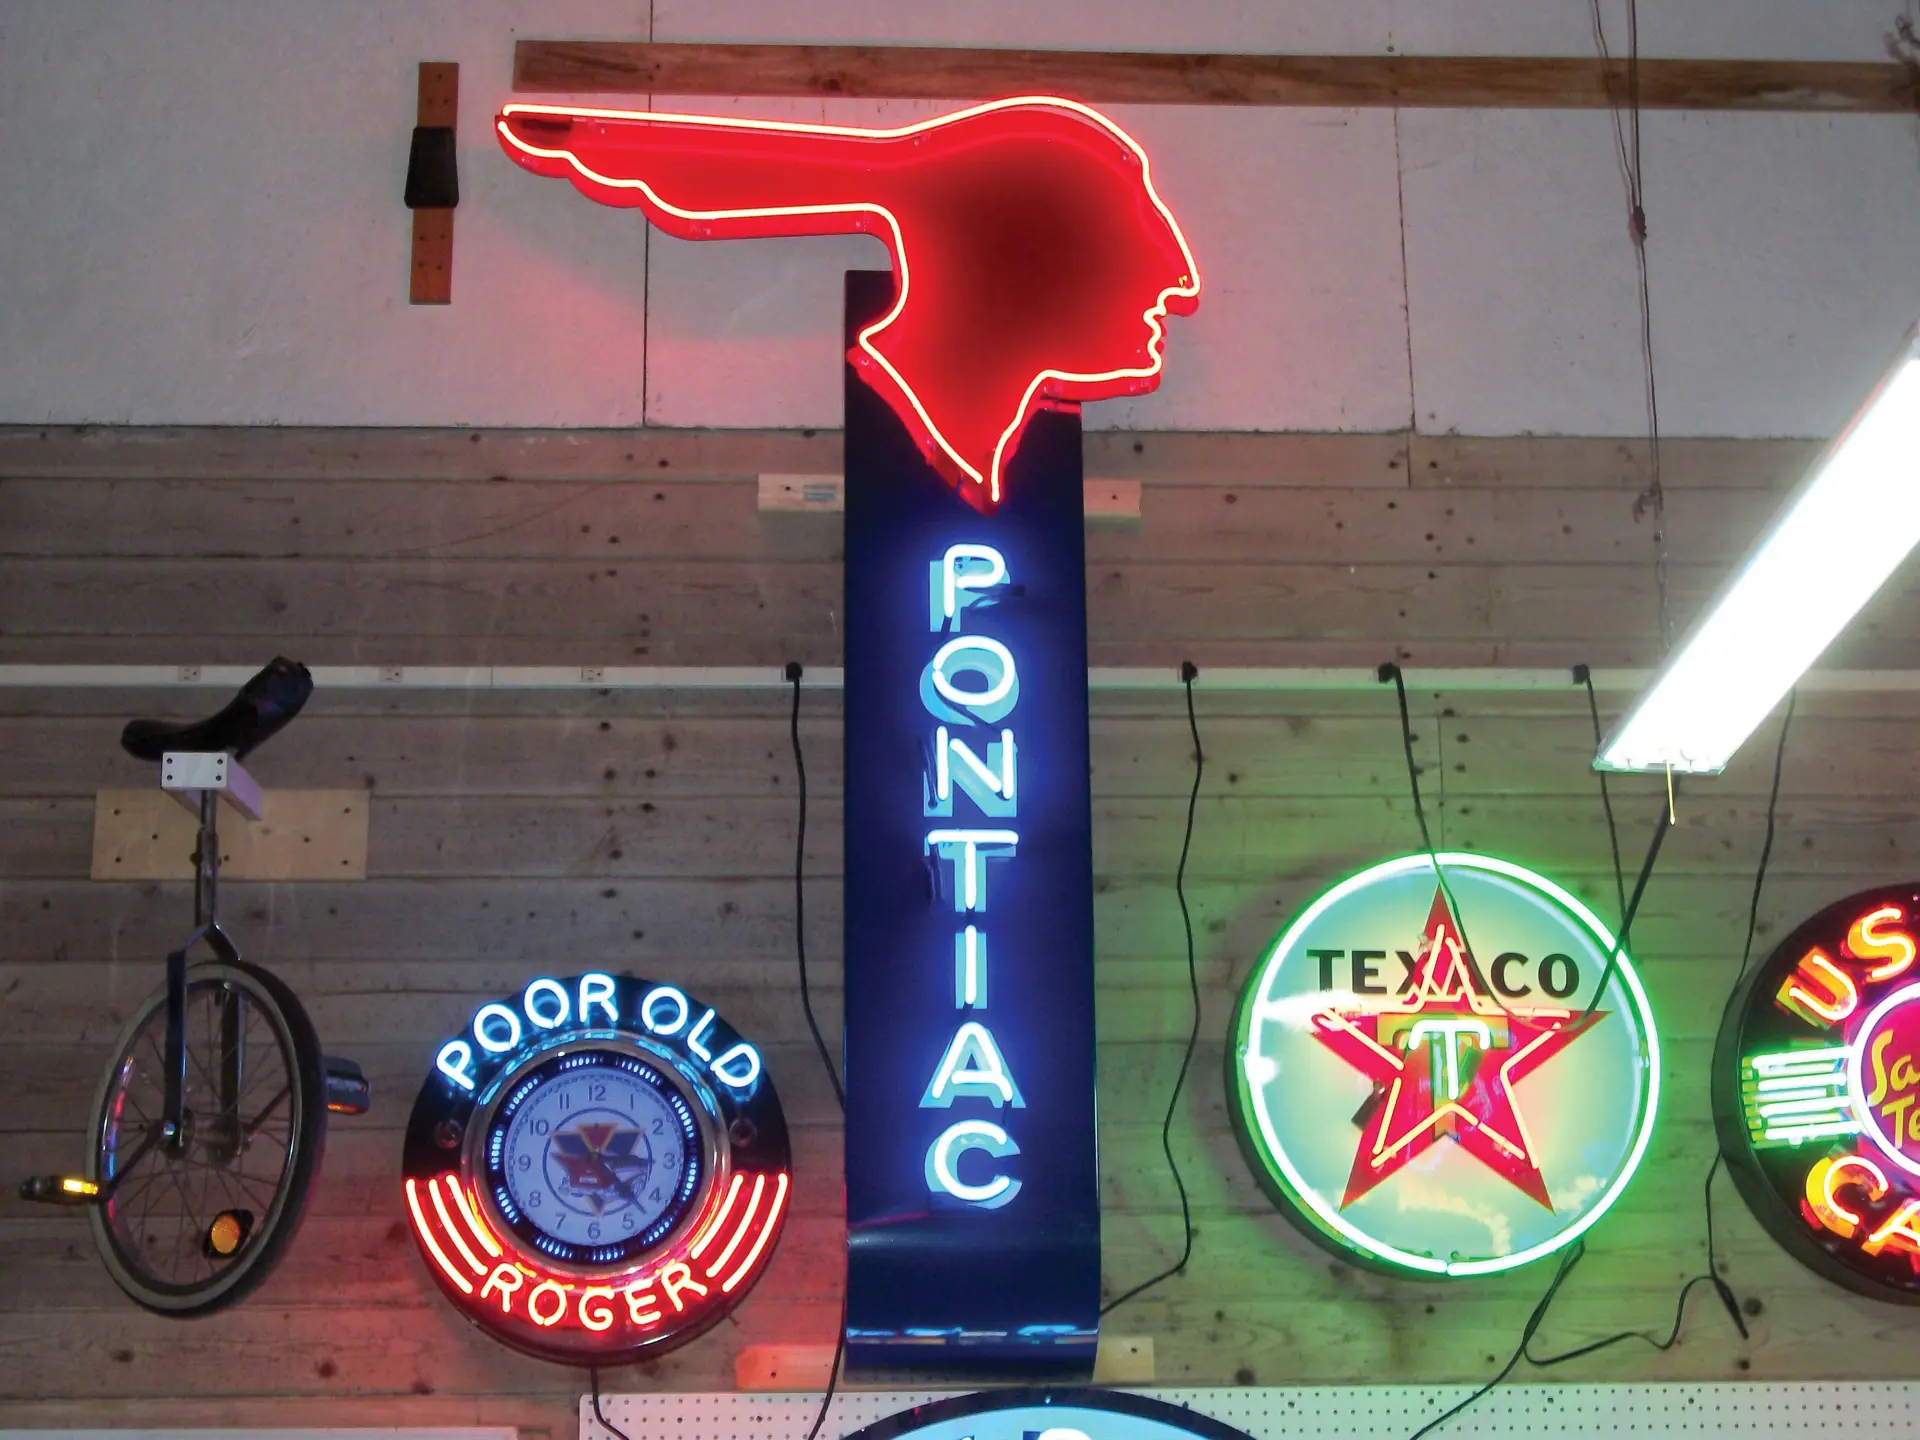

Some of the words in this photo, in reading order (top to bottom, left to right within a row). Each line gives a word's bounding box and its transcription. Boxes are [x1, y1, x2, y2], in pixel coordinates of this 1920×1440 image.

[919, 543, 1027, 1209] PONTIAC
[1306, 948, 1581, 999] TEXACO
[436, 972, 620, 1091] POOR
[640, 986, 763, 1088] OLD
[559, 1093, 570, 1110] 11
[587, 1084, 606, 1102] 12
[529, 1119, 550, 1136] 10
[652, 1118, 664, 1135] 2
[518, 1155, 532, 1171] 9
[662, 1152, 676, 1169] 3
[528, 1190, 542, 1208] 8
[648, 1187, 661, 1205] 4
[555, 1212, 567, 1229] 7
[621, 1212, 635, 1230] 5
[587, 1221, 601, 1239] 6
[481, 1264, 708, 1332] ROGER
